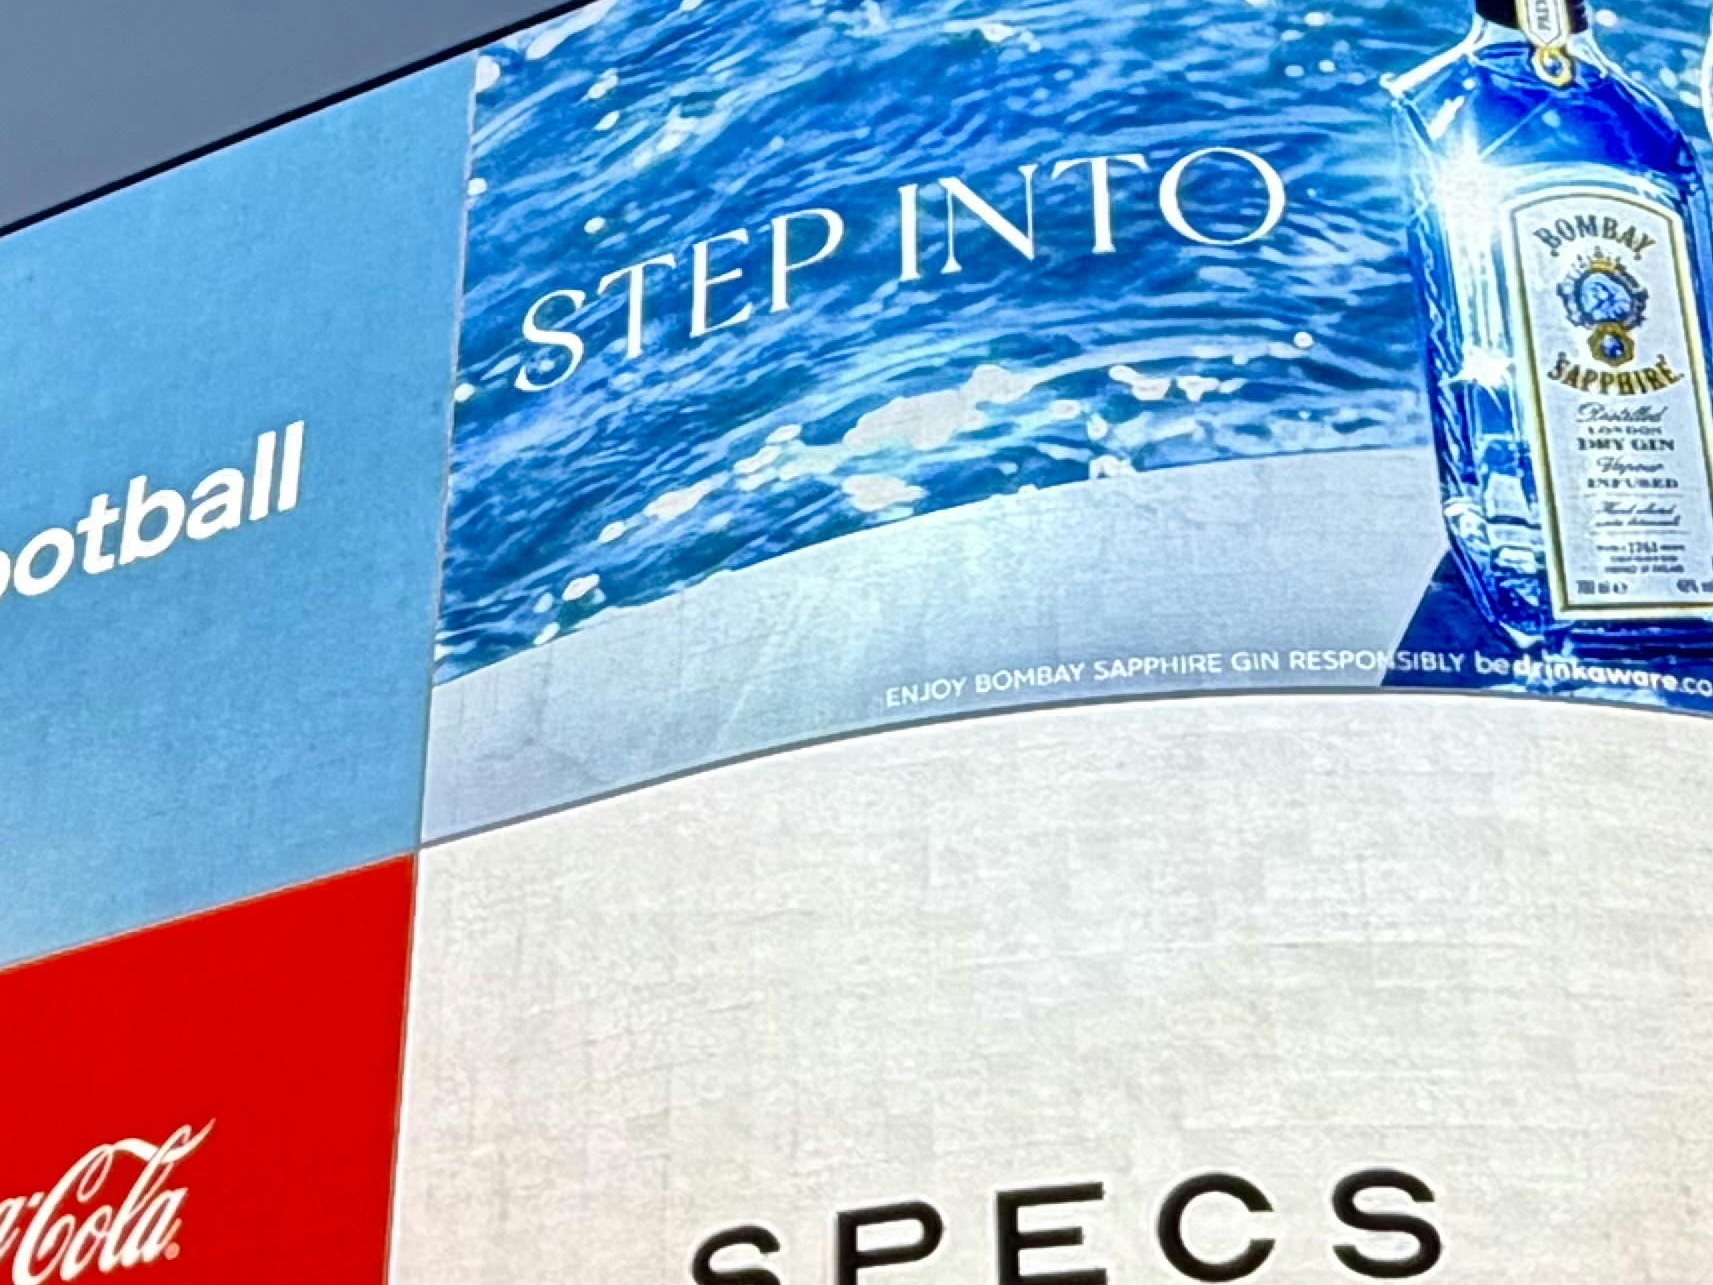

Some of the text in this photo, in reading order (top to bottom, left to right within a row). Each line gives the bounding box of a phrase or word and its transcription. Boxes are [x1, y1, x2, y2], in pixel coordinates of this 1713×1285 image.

[1532, 214, 1657, 259] BOMBAY
[513, 146, 1287, 395] STEP INTO
[1546, 353, 1685, 397] SAPPHIRE
[1576, 437, 1675, 451] DRY GIN
[886, 675, 967, 708] ENJOY
[975, 661, 1086, 694] BOMBAY
[1093, 653, 1223, 682] SAPPHIRE
[1230, 650, 1280, 672] GIN
[1289, 649, 1465, 672] RESPONSIBLY
